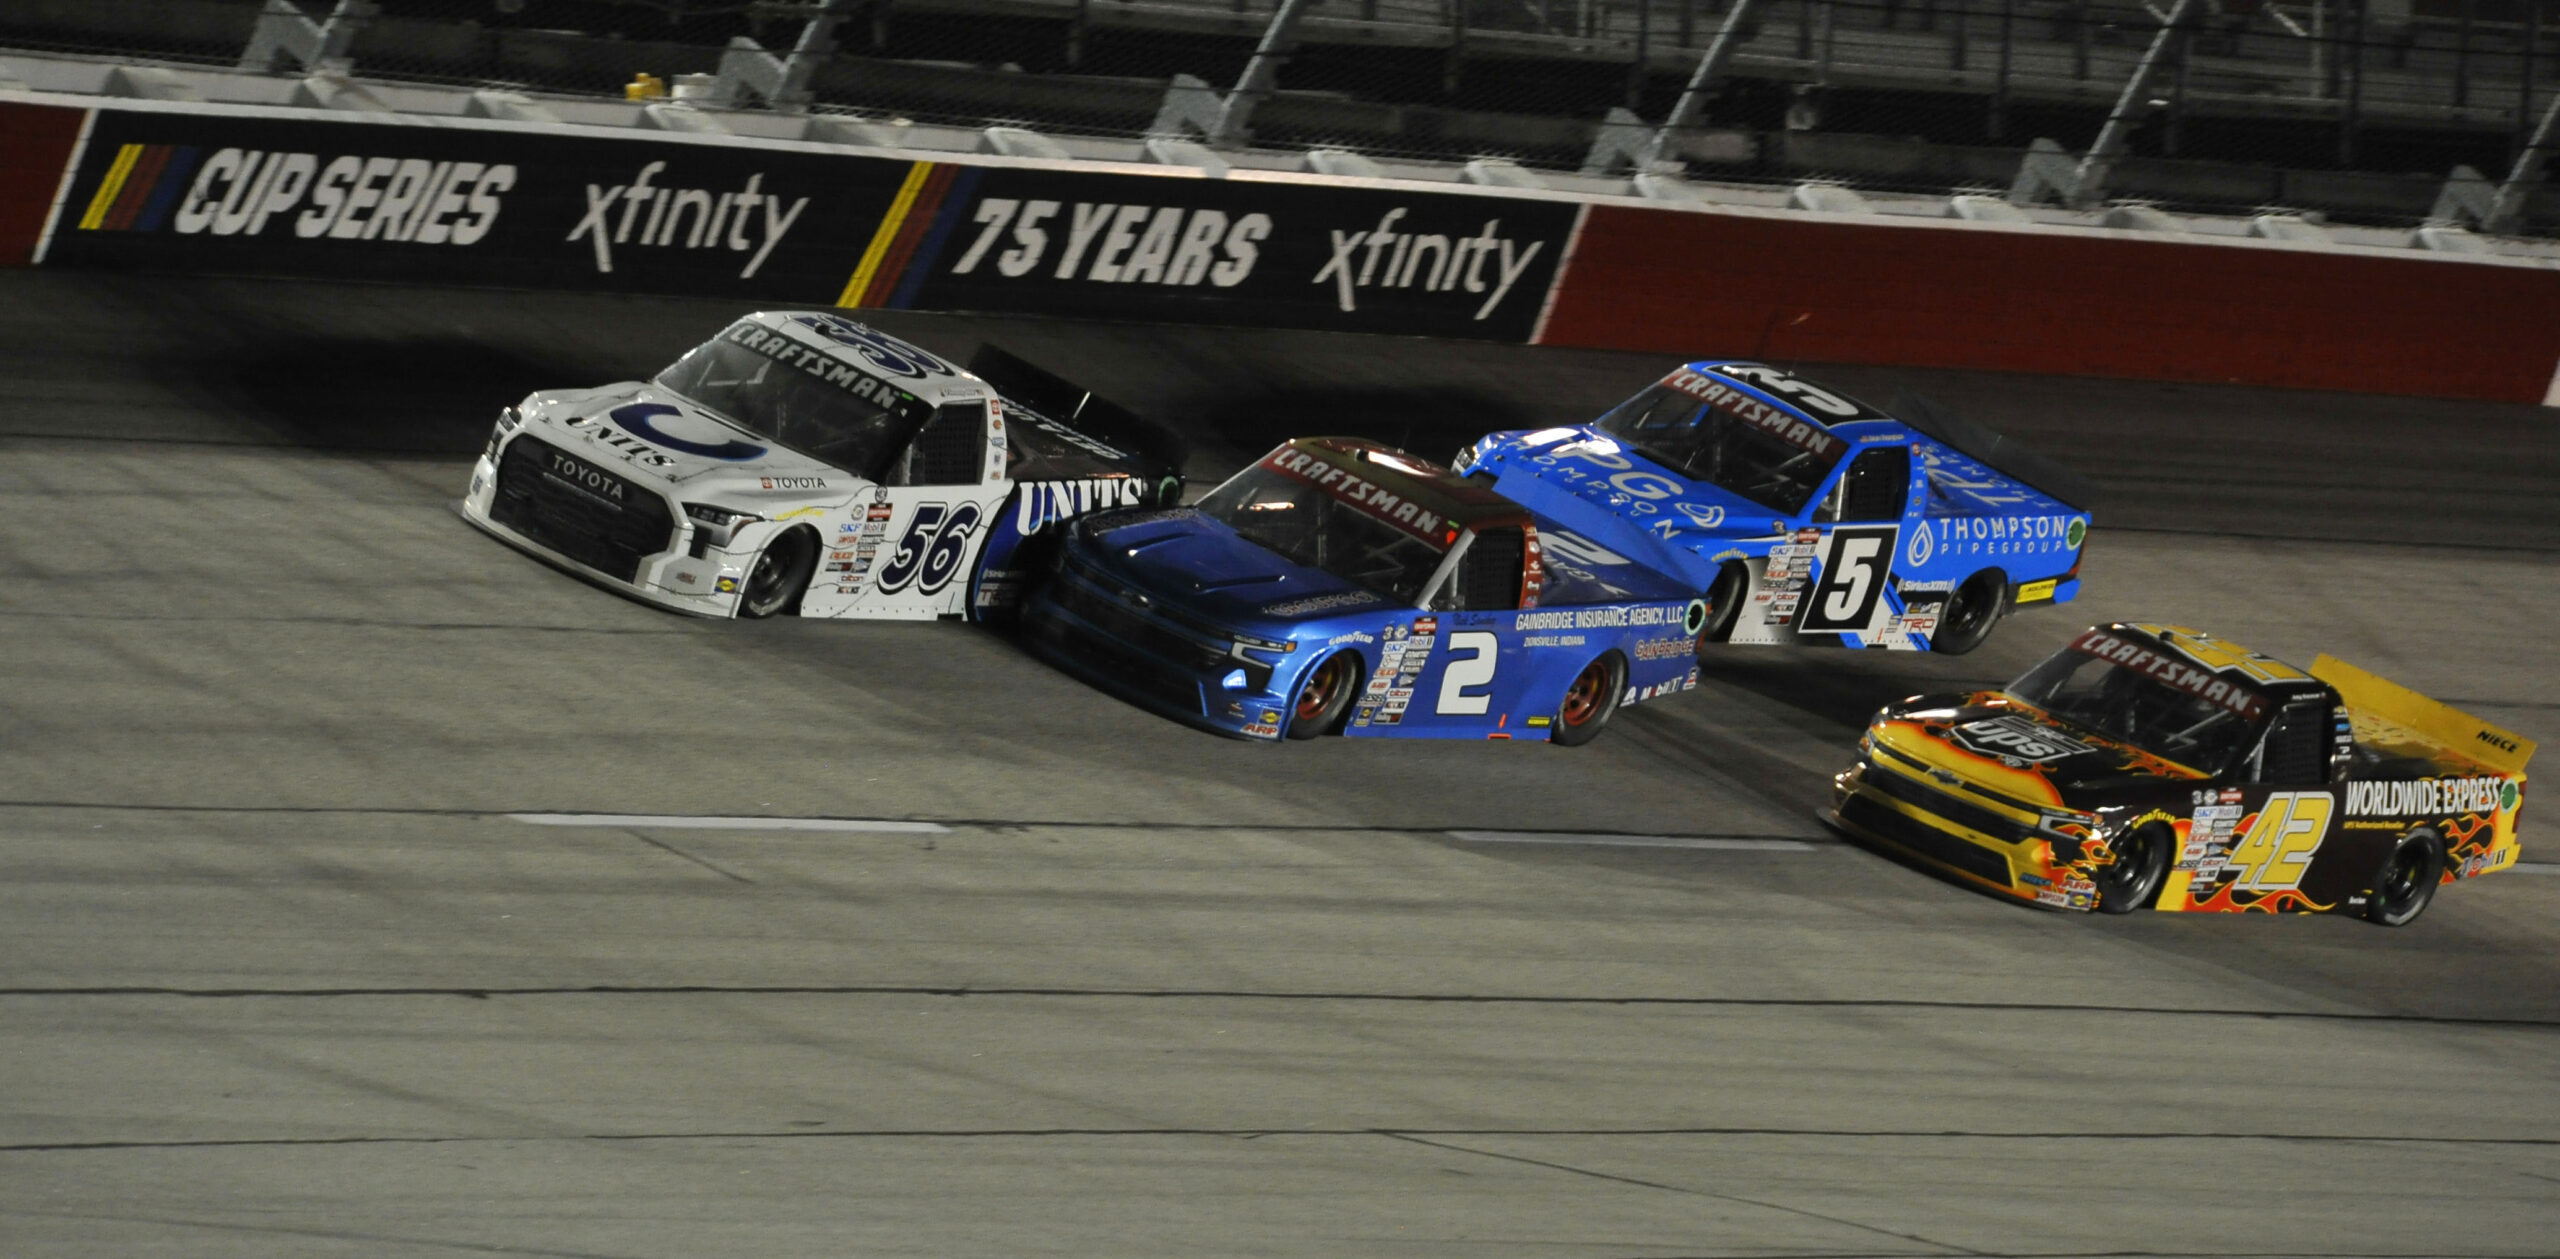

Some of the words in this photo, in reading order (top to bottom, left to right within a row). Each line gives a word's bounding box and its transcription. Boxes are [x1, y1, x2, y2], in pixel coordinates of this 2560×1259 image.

[174, 147, 318, 236] CUP
[295, 157, 517, 247] SERIES
[567, 160, 809, 280] xfinity
[952, 198, 1064, 276] 75
[1054, 202, 1273, 287] YEARS
[1312, 207, 1544, 320] xfinity
[729, 325, 897, 409] CRAFTSMAN
[565, 417, 675, 467] UNITS
[1673, 371, 1833, 454] CRAFTSMAN
[552, 454, 623, 499] TOYOTA
[775, 476, 827, 489] TOYOTA
[1017, 477, 1142, 536] UNITS
[1273, 449, 1440, 534] CRAFTSMAN
[877, 501, 982, 596] 56
[1940, 516, 2065, 541] THOMPSON
[1515, 610, 1574, 631] GAINBRIDGE
[1576, 608, 1628, 628] INSURANCE
[1630, 606, 1665, 625] AGENCY,
[1667, 605, 1684, 624] LLC
[1824, 537, 1882, 621] 5
[1903, 618, 1935, 633] TRD
[1436, 631, 1498, 715] 2
[2081, 634, 2253, 709] CRAFTSMAN
[1961, 720, 2056, 757] ups
[2476, 730, 2518, 753] NIECE
[2345, 781, 2442, 816] WORLDWIDE
[2443, 776, 2501, 813] EXPRESS
[2224, 791, 2335, 890] 42
